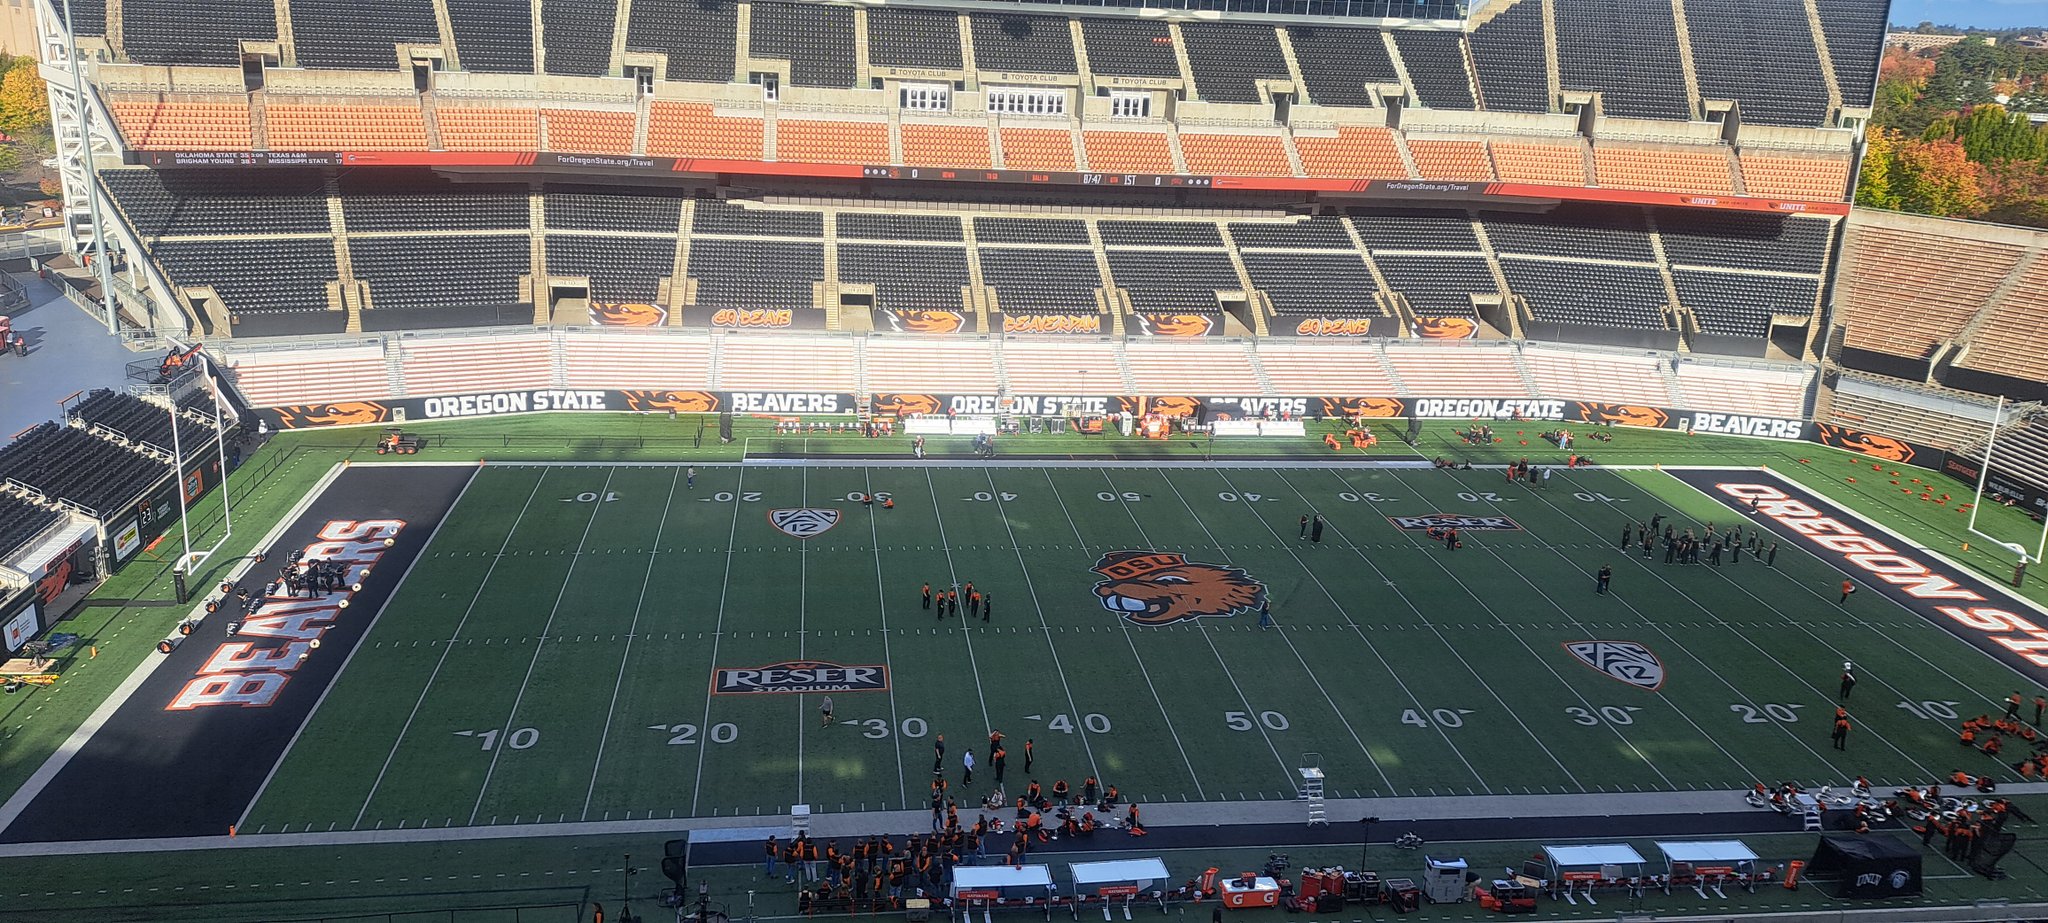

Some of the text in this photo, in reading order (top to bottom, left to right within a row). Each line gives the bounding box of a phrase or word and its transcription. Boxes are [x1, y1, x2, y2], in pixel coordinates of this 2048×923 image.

[1011, 73, 1037, 81] TOYOTA
[557, 155, 654, 167] ForOregonState.org/Travel
[1386, 182, 1469, 192] ForOregonState.org/Travel
[1691, 197, 1717, 206] UNITE
[1780, 202, 1806, 211] UNITE
[712, 307, 793, 328] GO BEAVS
[1297, 319, 1320, 336] GO
[425, 390, 605, 418] OREGON STATE
[731, 393, 837, 412] BEAVERS
[1415, 399, 1566, 419] OREGON STATE
[1692, 412, 1802, 438] BEAVERS
[576, 491, 623, 502] 10
[714, 491, 762, 502] 20
[974, 491, 1018, 502] 40
[1097, 491, 1142, 502] 50
[1218, 491, 1262, 502] 40
[1338, 491, 1385, 502] 30
[1457, 491, 1504, 502] 20
[1573, 491, 1620, 502] 10
[141, 508, 152, 526] 23
[1397, 517, 1515, 528] RESER
[1714, 483, 1988, 602] OREGON
[1109, 554, 1179, 578] OSU
[722, 667, 881, 688] RESER
[752, 684, 851, 693] STADIUM
[1564, 706, 1635, 727] 30
[1730, 703, 1799, 724] 20
[1896, 700, 1960, 720] 10
[1048, 712, 1112, 735] 40
[1225, 710, 1291, 732] 50
[1400, 708, 1465, 730] 40
[667, 722, 739, 746] 20
[862, 716, 929, 740] 30
[476, 727, 540, 751] 10
[1232, 893, 1244, 905] G
[1263, 891, 1275, 903] G
